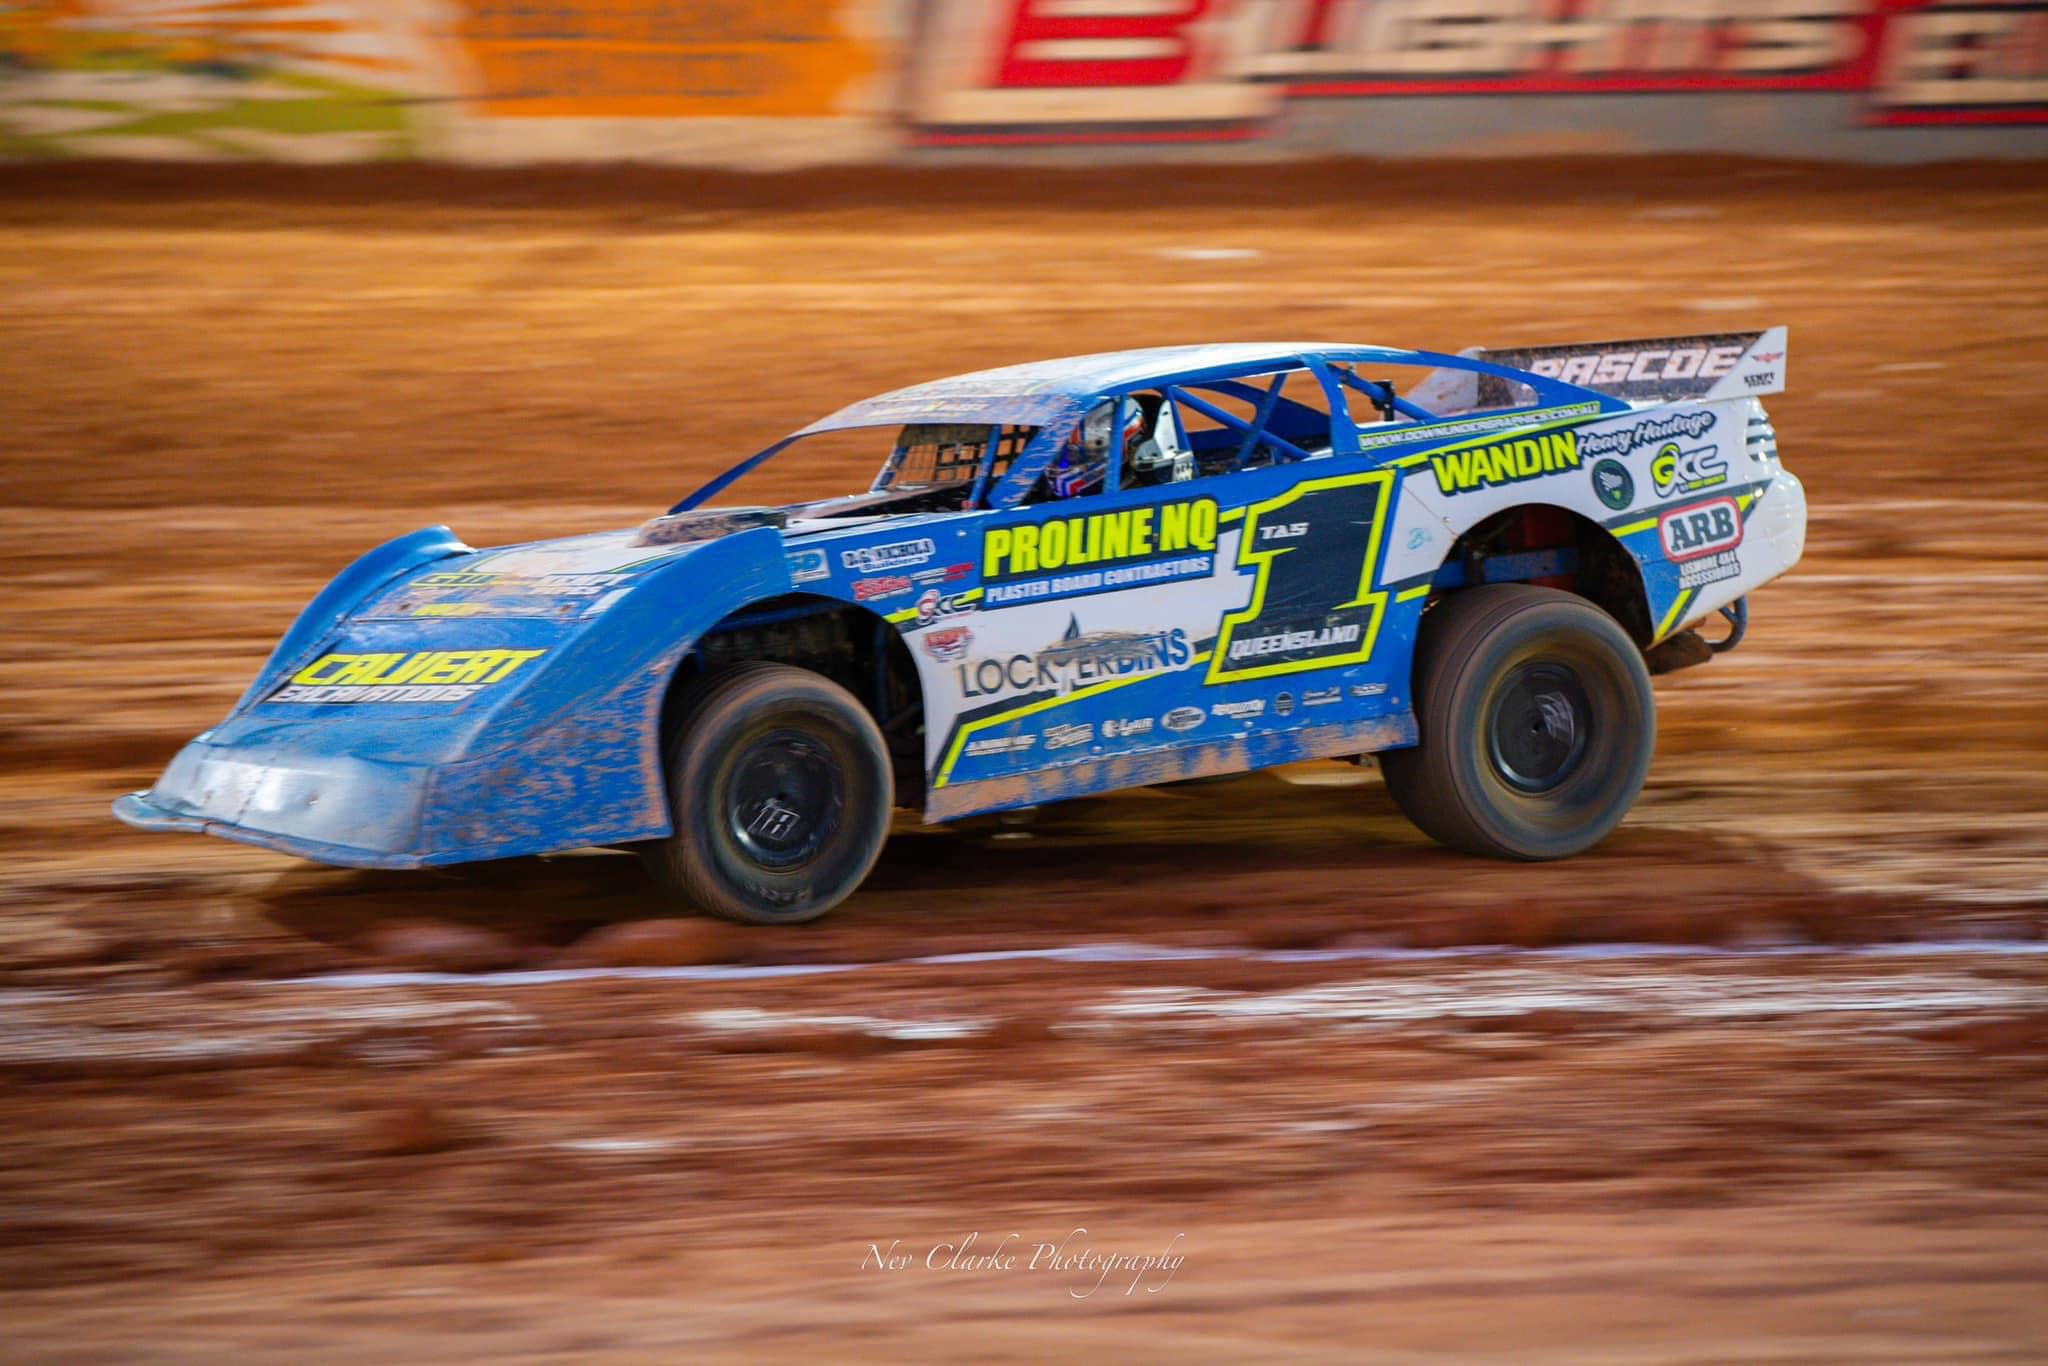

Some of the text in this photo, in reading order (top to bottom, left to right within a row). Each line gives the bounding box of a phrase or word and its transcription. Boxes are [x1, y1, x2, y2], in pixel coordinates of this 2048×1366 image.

[1530, 346, 1744, 385] PASCOE
[1432, 411, 1715, 494] WANDIN Heavy Haulage
[983, 498, 1218, 578] PROLINE NQ
[1258, 522, 1310, 540] TAS
[1669, 506, 1735, 553] ARB
[986, 557, 1210, 603] PLASTER BOARD CONTRACTORS
[1203, 468, 1397, 686] 1
[1230, 623, 1361, 661] QUEENSLAND
[289, 648, 548, 686] CALVERT
